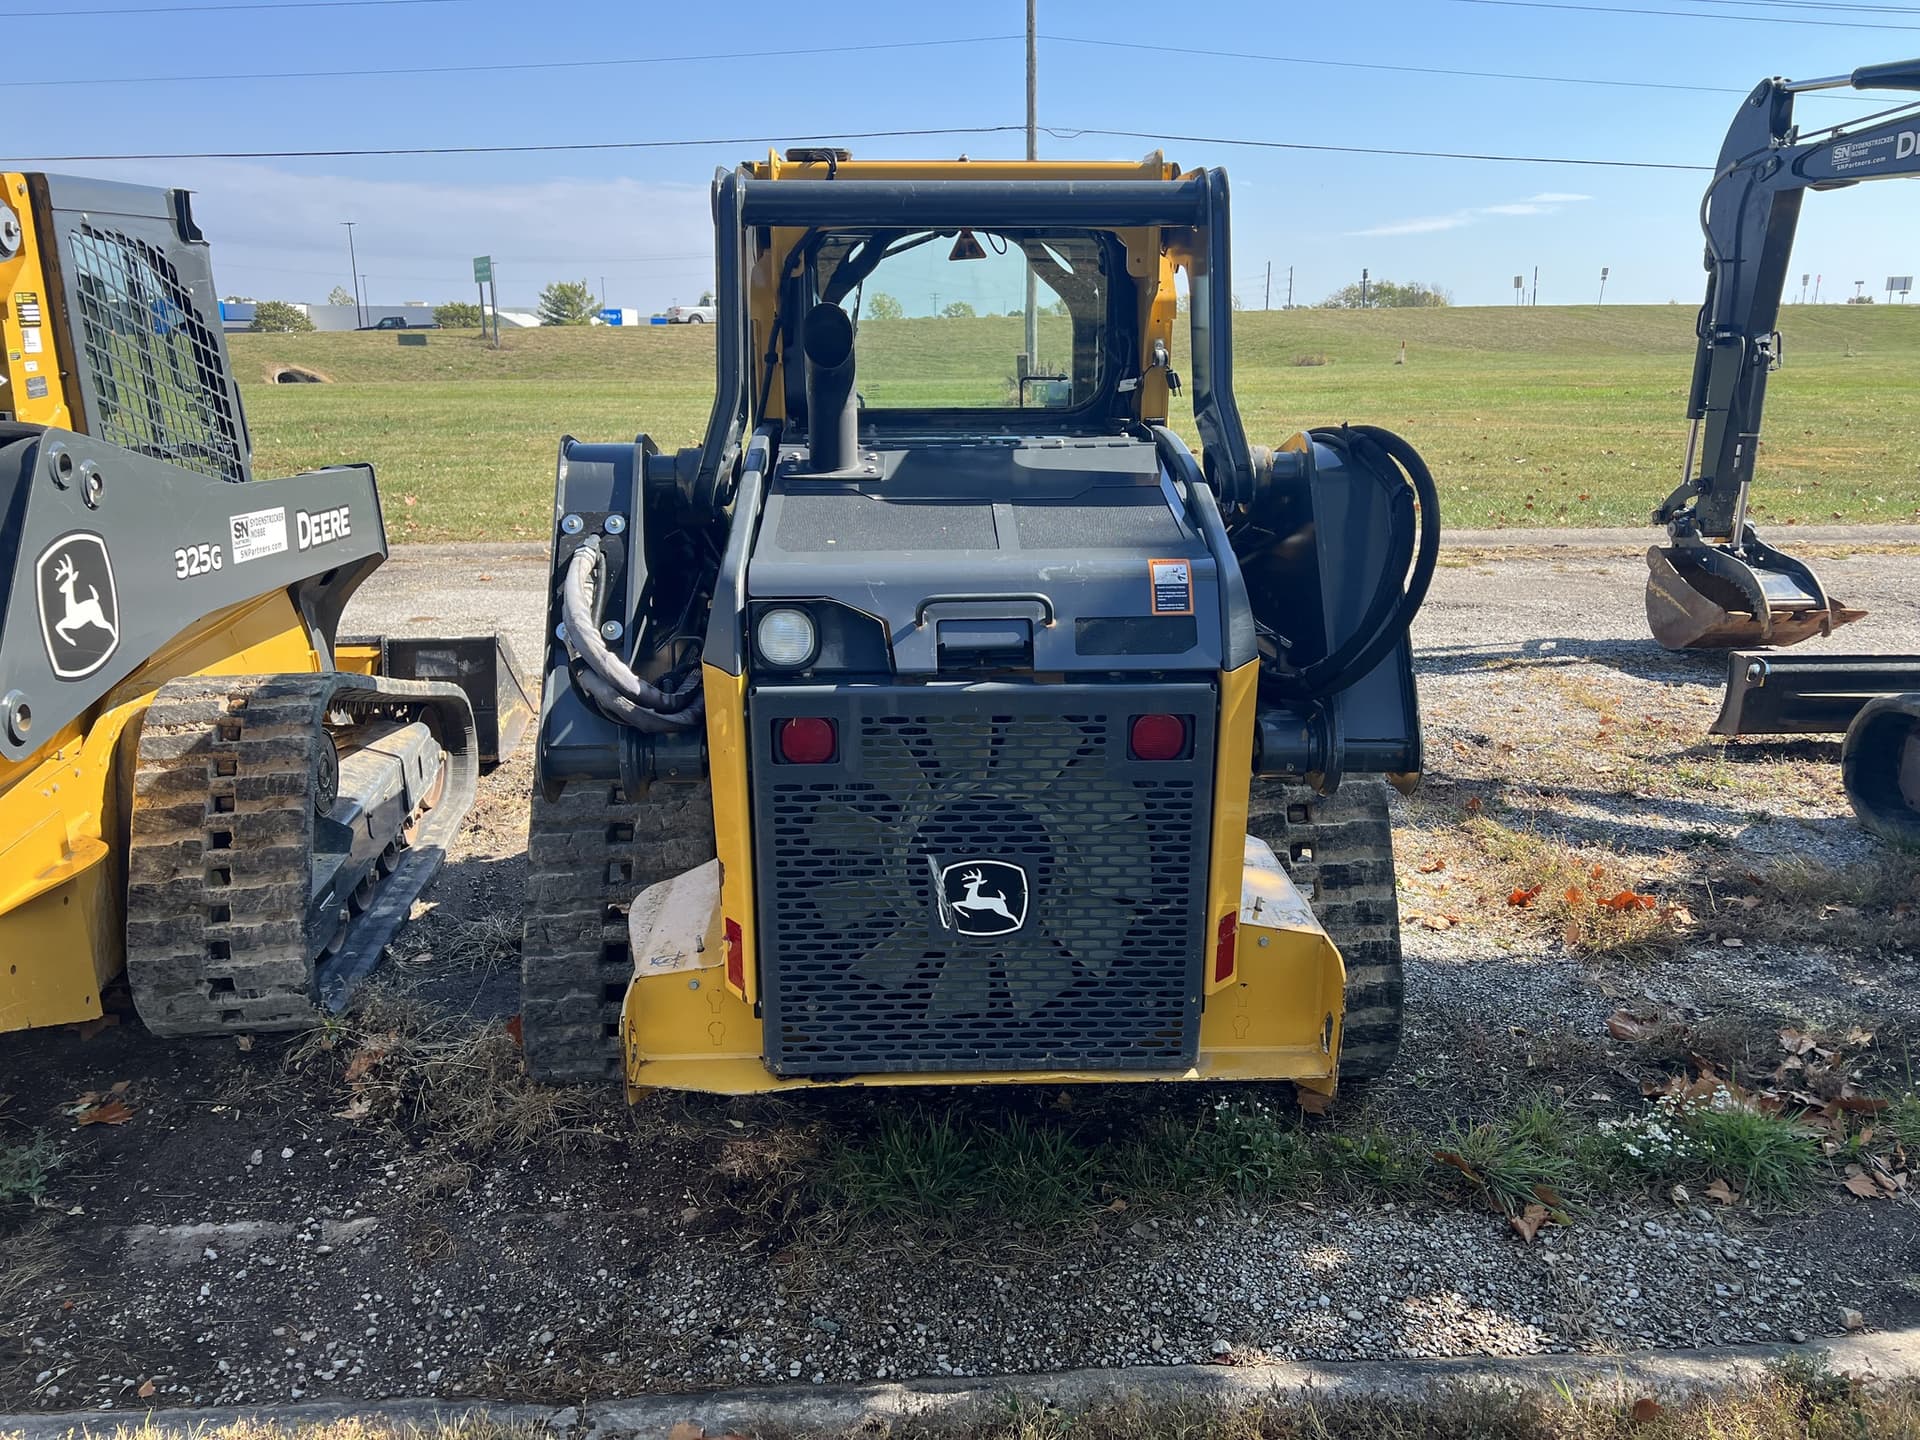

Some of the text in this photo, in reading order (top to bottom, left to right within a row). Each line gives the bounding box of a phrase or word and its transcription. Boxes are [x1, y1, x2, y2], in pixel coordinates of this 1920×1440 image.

[1834, 146, 1850, 159] SN
[1837, 157, 1887, 170] SNPartners.com
[233, 520, 249, 539] SN
[296, 506, 352, 550] DEERE
[240, 542, 283, 559] SNPartners.com
[175, 543, 222, 579] 325G
